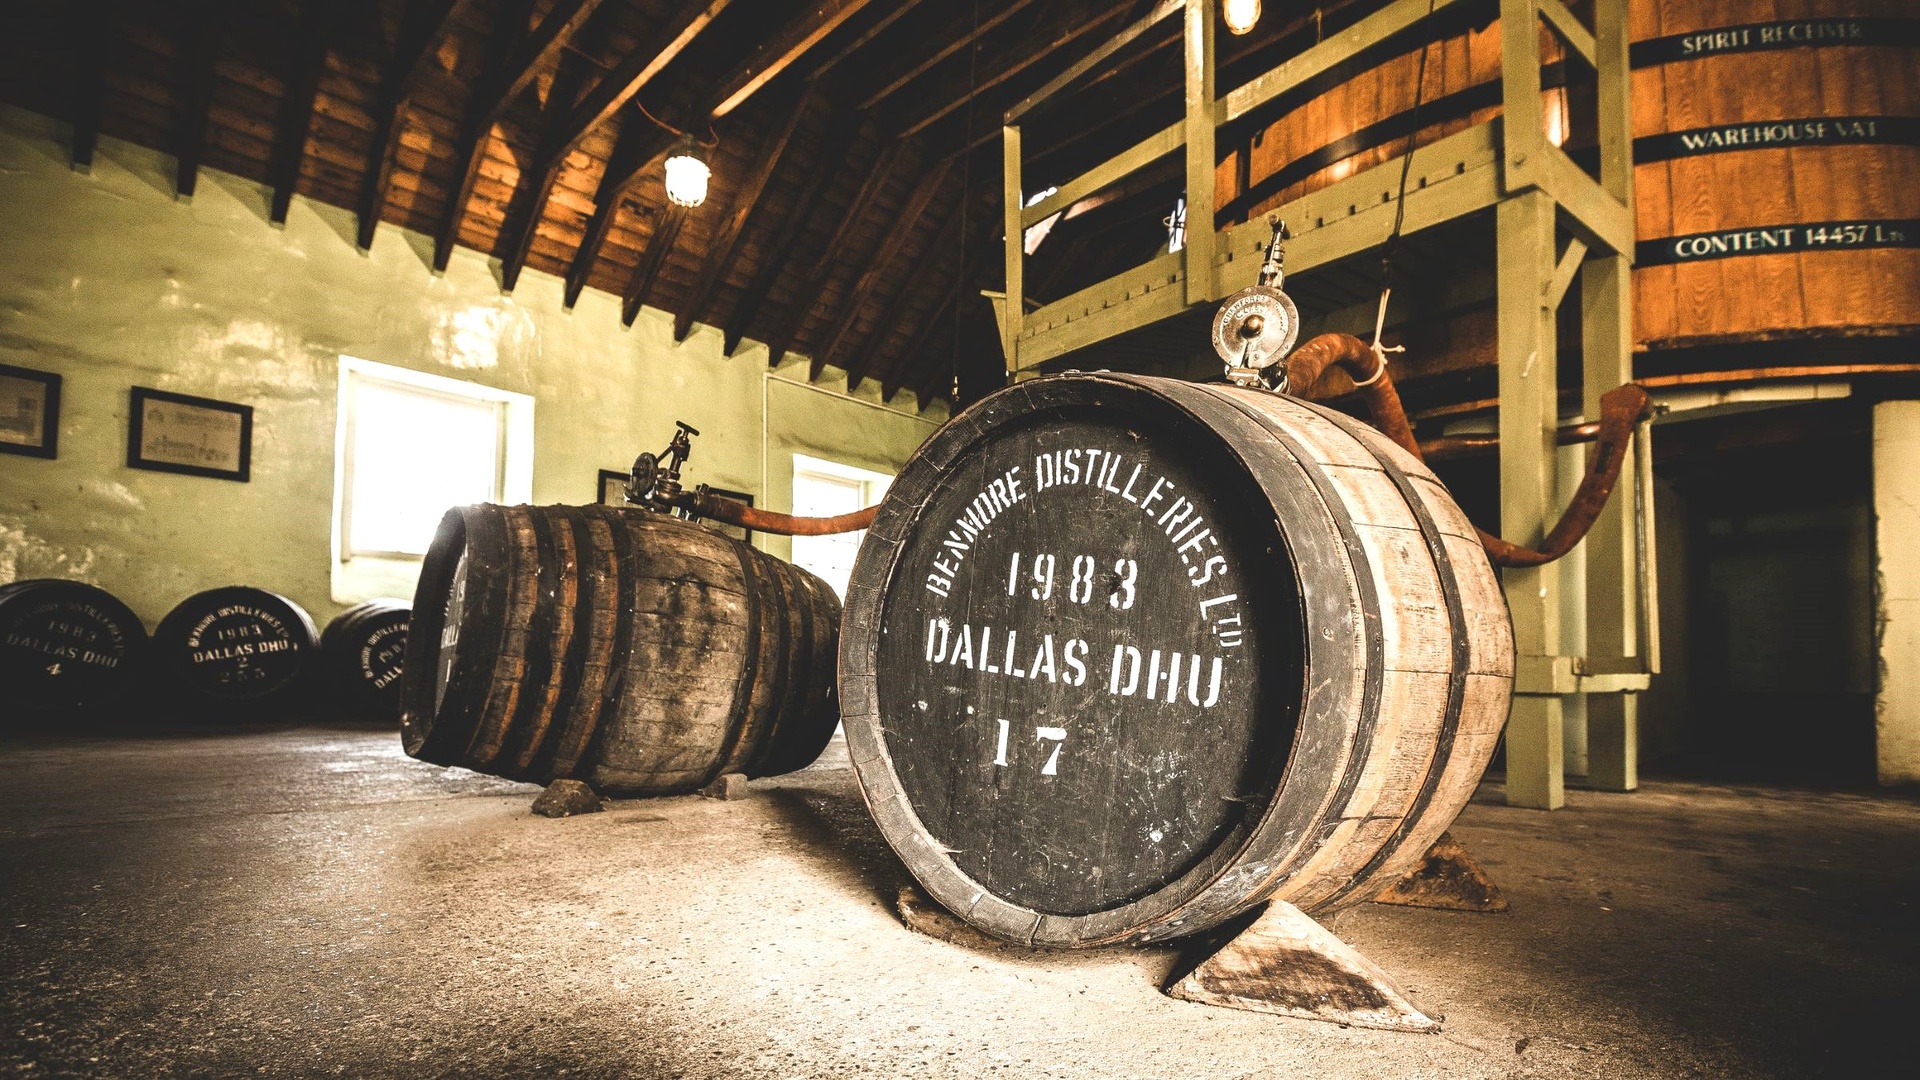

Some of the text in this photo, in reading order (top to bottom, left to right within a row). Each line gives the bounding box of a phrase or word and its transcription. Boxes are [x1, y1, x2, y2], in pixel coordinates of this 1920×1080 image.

[1682, 20, 1863, 54] SPIRIT RECEIVER
[1681, 121, 1877, 151] WAREHOUSE VAT
[1675, 228, 1796, 258] CONTENT
[1805, 225, 1869, 246] 14457
[925, 449, 1242, 648] BENMORE DISTILLERIES LTD
[1008, 551, 1139, 610] 1983
[217, 623, 264, 641] 1983
[6, 633, 79, 660] DALLAS
[82, 650, 119, 669] DHU
[193, 639, 289, 663] DALLAS DHU
[925, 618, 1223, 708] DALLAS DHU
[45, 662, 63, 676] 4
[374, 665, 404, 689] DALL
